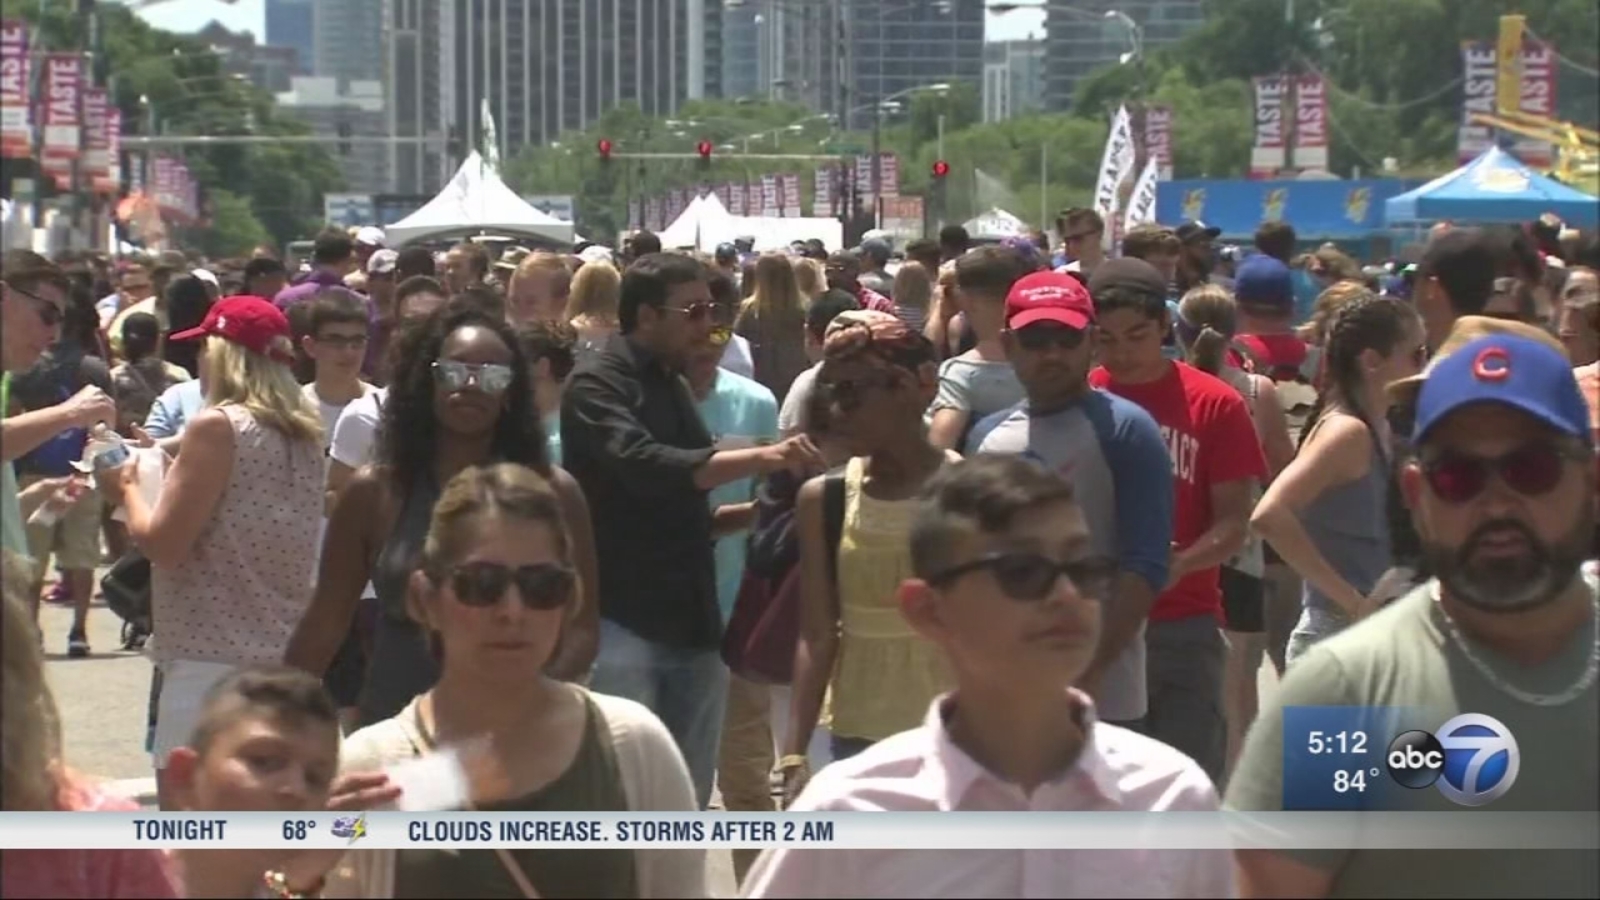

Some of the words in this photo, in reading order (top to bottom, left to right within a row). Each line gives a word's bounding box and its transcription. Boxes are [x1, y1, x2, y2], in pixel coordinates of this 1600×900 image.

[49, 59, 76, 124] TASTE
[1465, 49, 1496, 124] TASTE
[1519, 48, 1549, 113] ASTE
[83, 93, 107, 147] TASTE
[1256, 83, 1281, 146] TASTE
[1298, 82, 1323, 146] TASTE
[814, 170, 829, 202] TASTE
[855, 155, 871, 193] TASTE
[879, 155, 896, 193] TASTE
[1473, 345, 1509, 382] C
